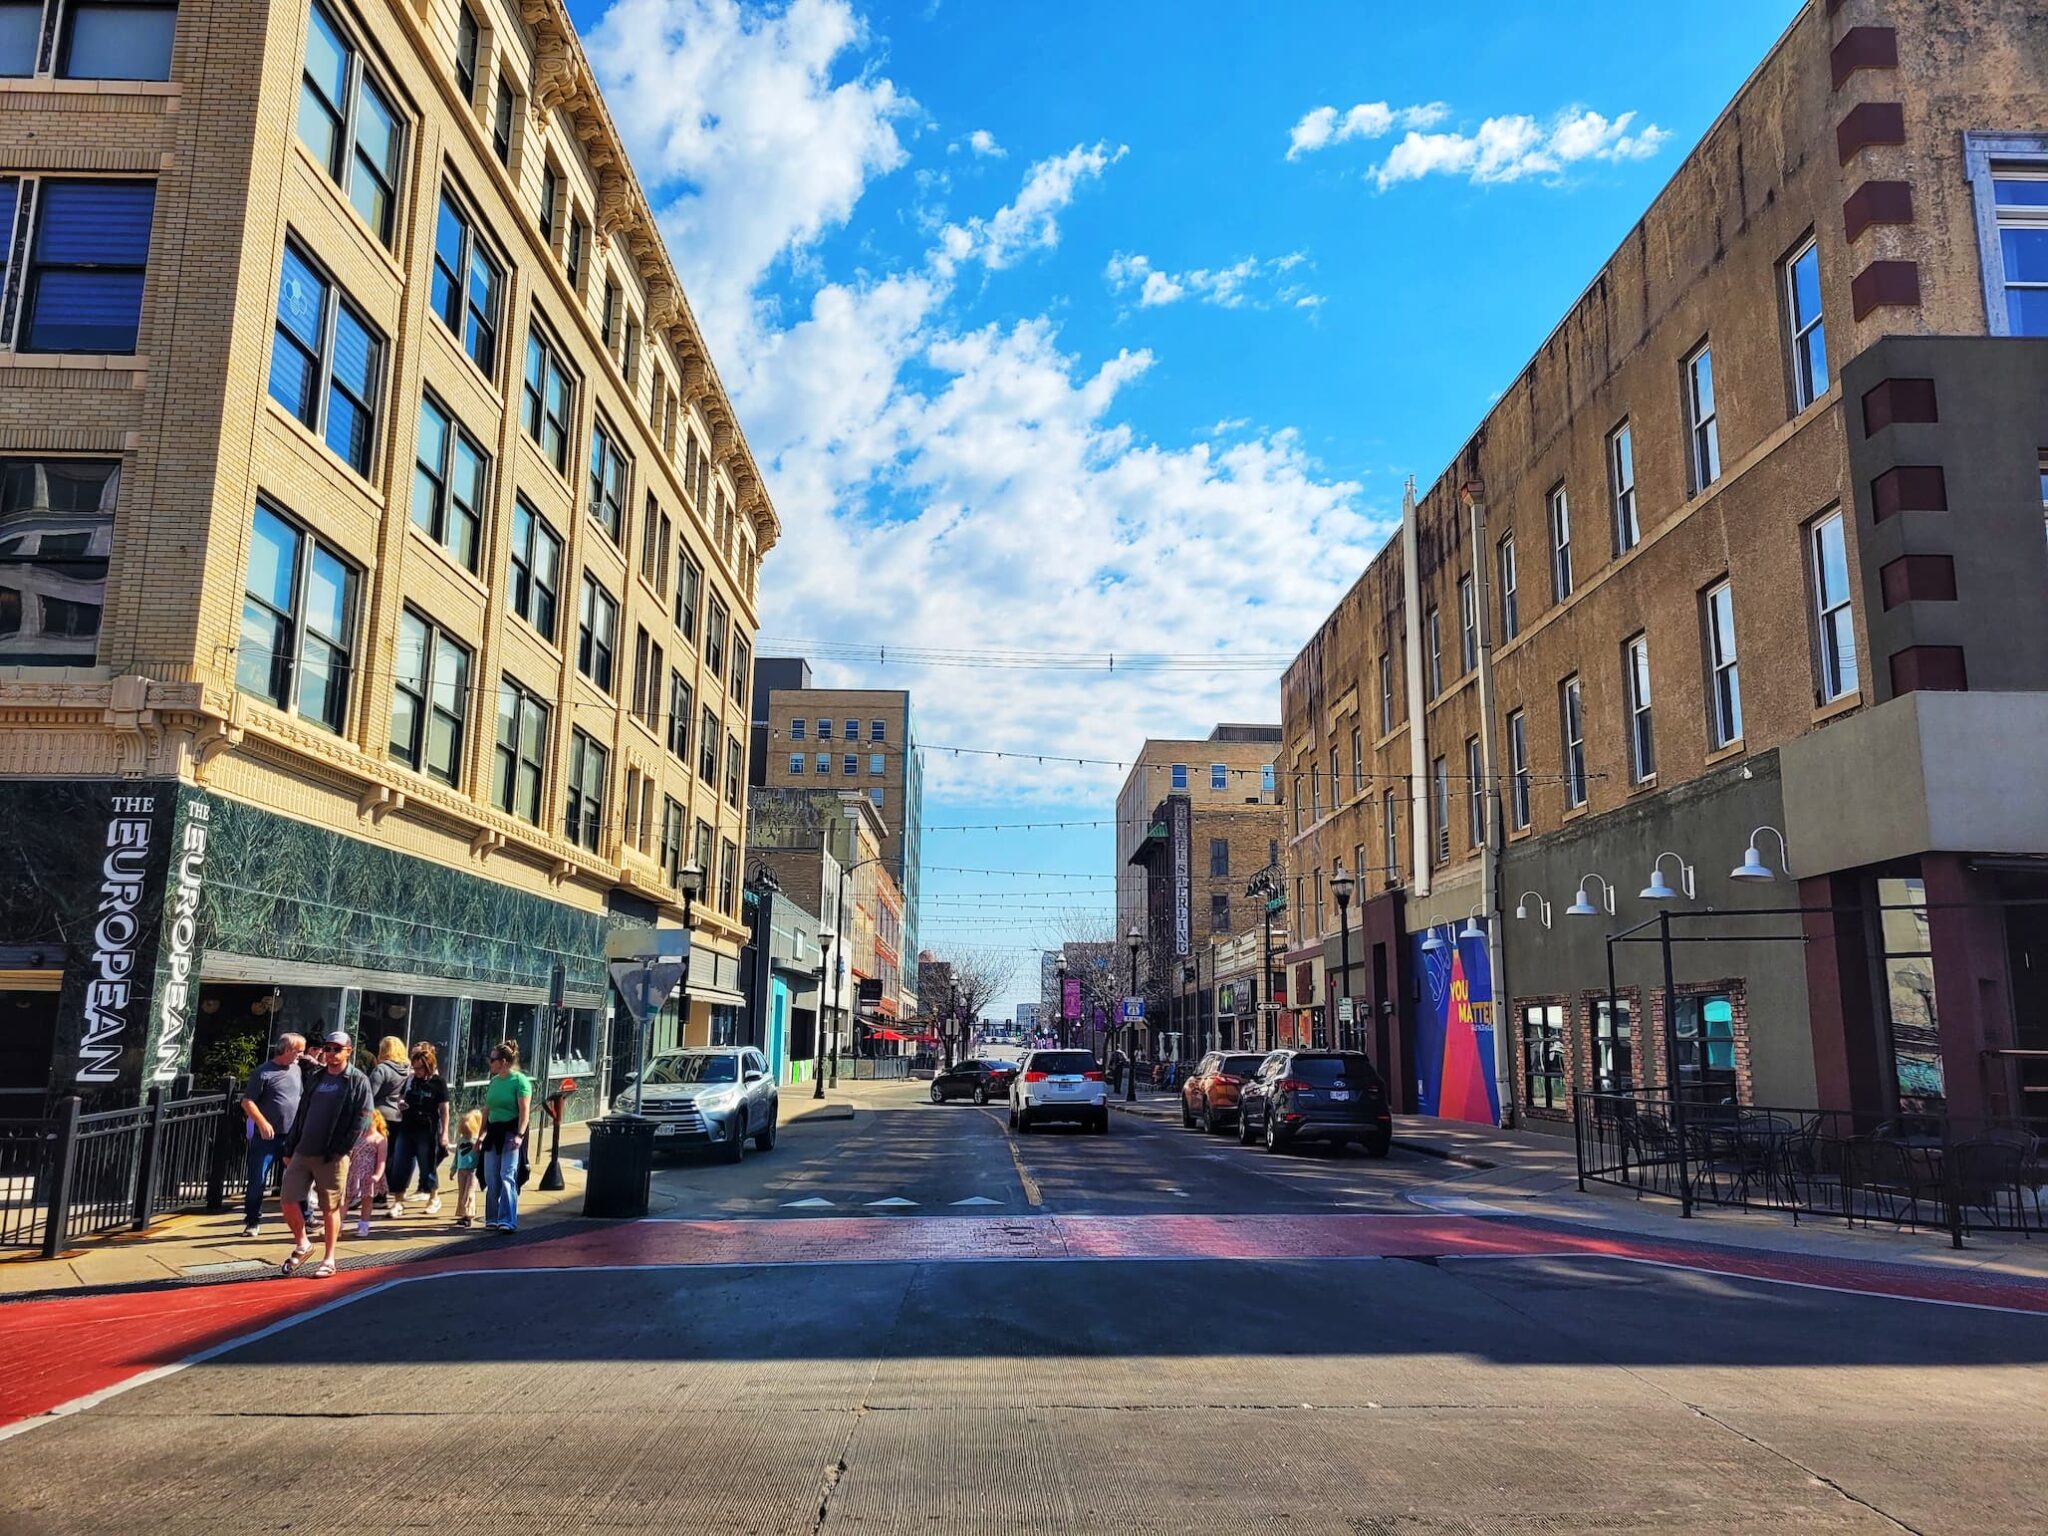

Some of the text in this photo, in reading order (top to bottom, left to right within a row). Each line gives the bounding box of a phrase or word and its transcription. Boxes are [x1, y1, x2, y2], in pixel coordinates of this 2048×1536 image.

[75, 796, 155, 1083] THE EUROPEAN
[153, 800, 211, 1081] THE EUROPEAN
[1175, 805, 1189, 955] HOTEL STERLING
[1449, 979, 1469, 1003] YOU
